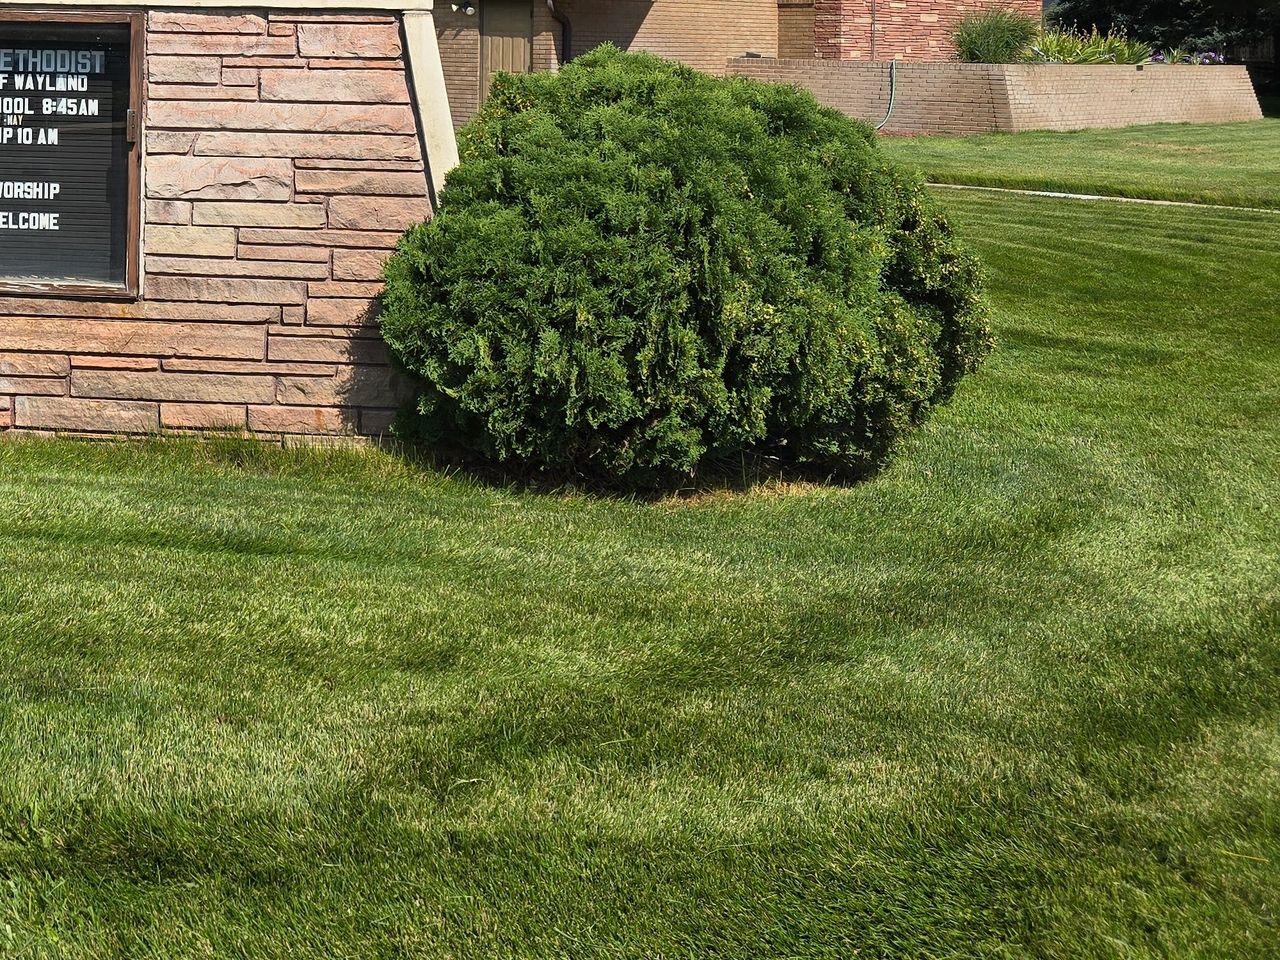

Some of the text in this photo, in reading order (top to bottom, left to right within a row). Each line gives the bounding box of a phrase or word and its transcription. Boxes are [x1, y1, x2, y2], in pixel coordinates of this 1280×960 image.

[14, 74, 88, 91] WAYLAND
[17, 128, 33, 144] 10
[37, 128, 59, 145] AM
